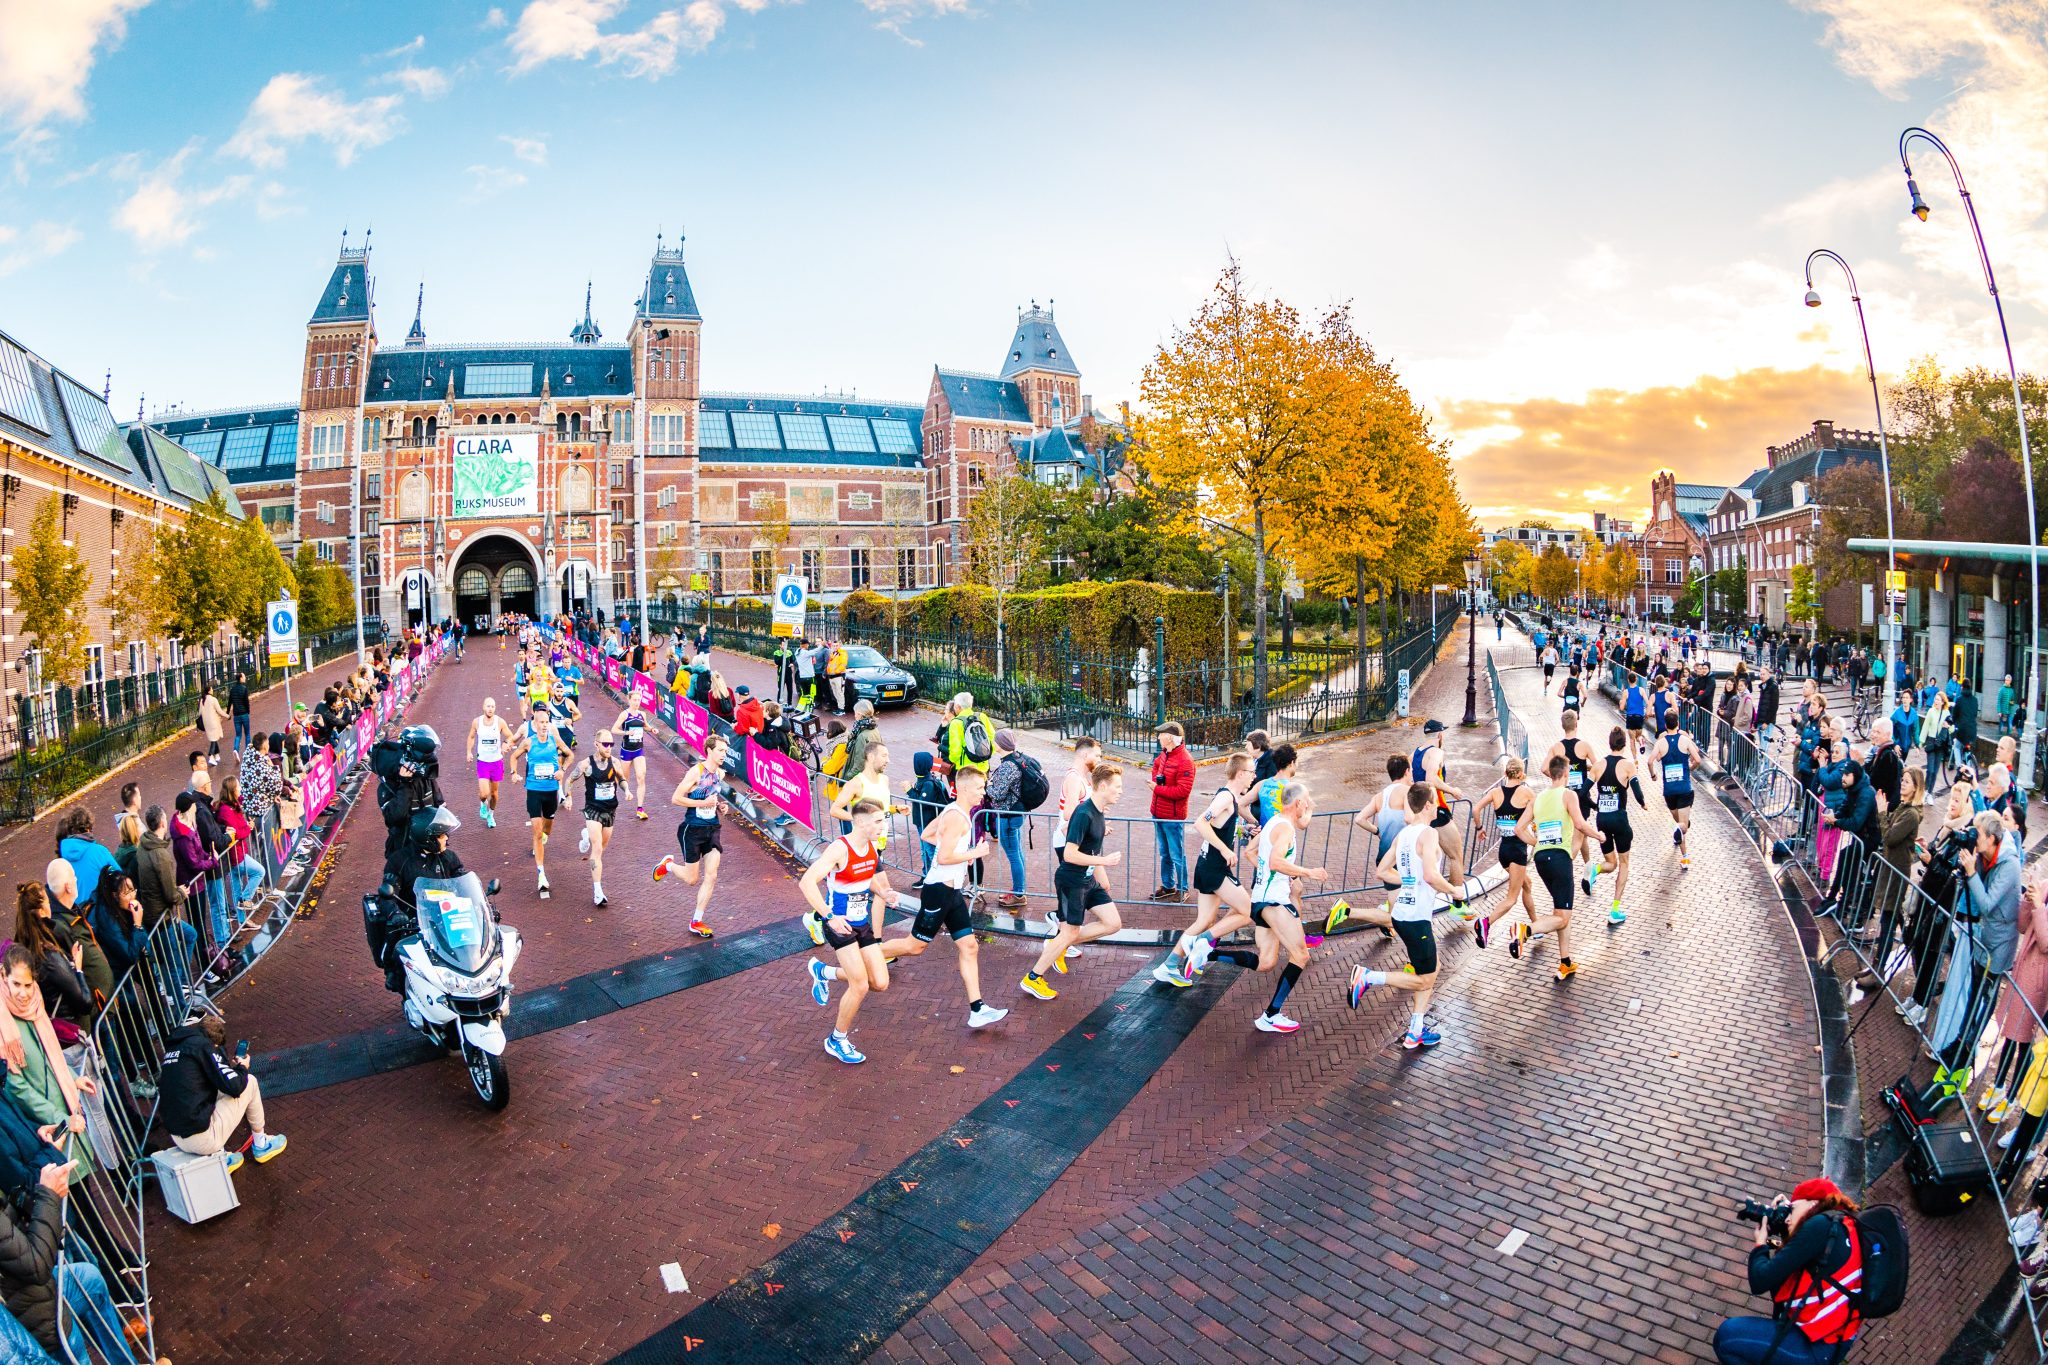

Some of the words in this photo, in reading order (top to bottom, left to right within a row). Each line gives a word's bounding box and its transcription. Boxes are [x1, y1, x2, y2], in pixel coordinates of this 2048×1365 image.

[457, 439, 513, 455] CLARA
[753, 750, 771, 791] tcs
[771, 772, 802, 798] CONSULTANCY
[771, 785, 792, 804] SERVICES
